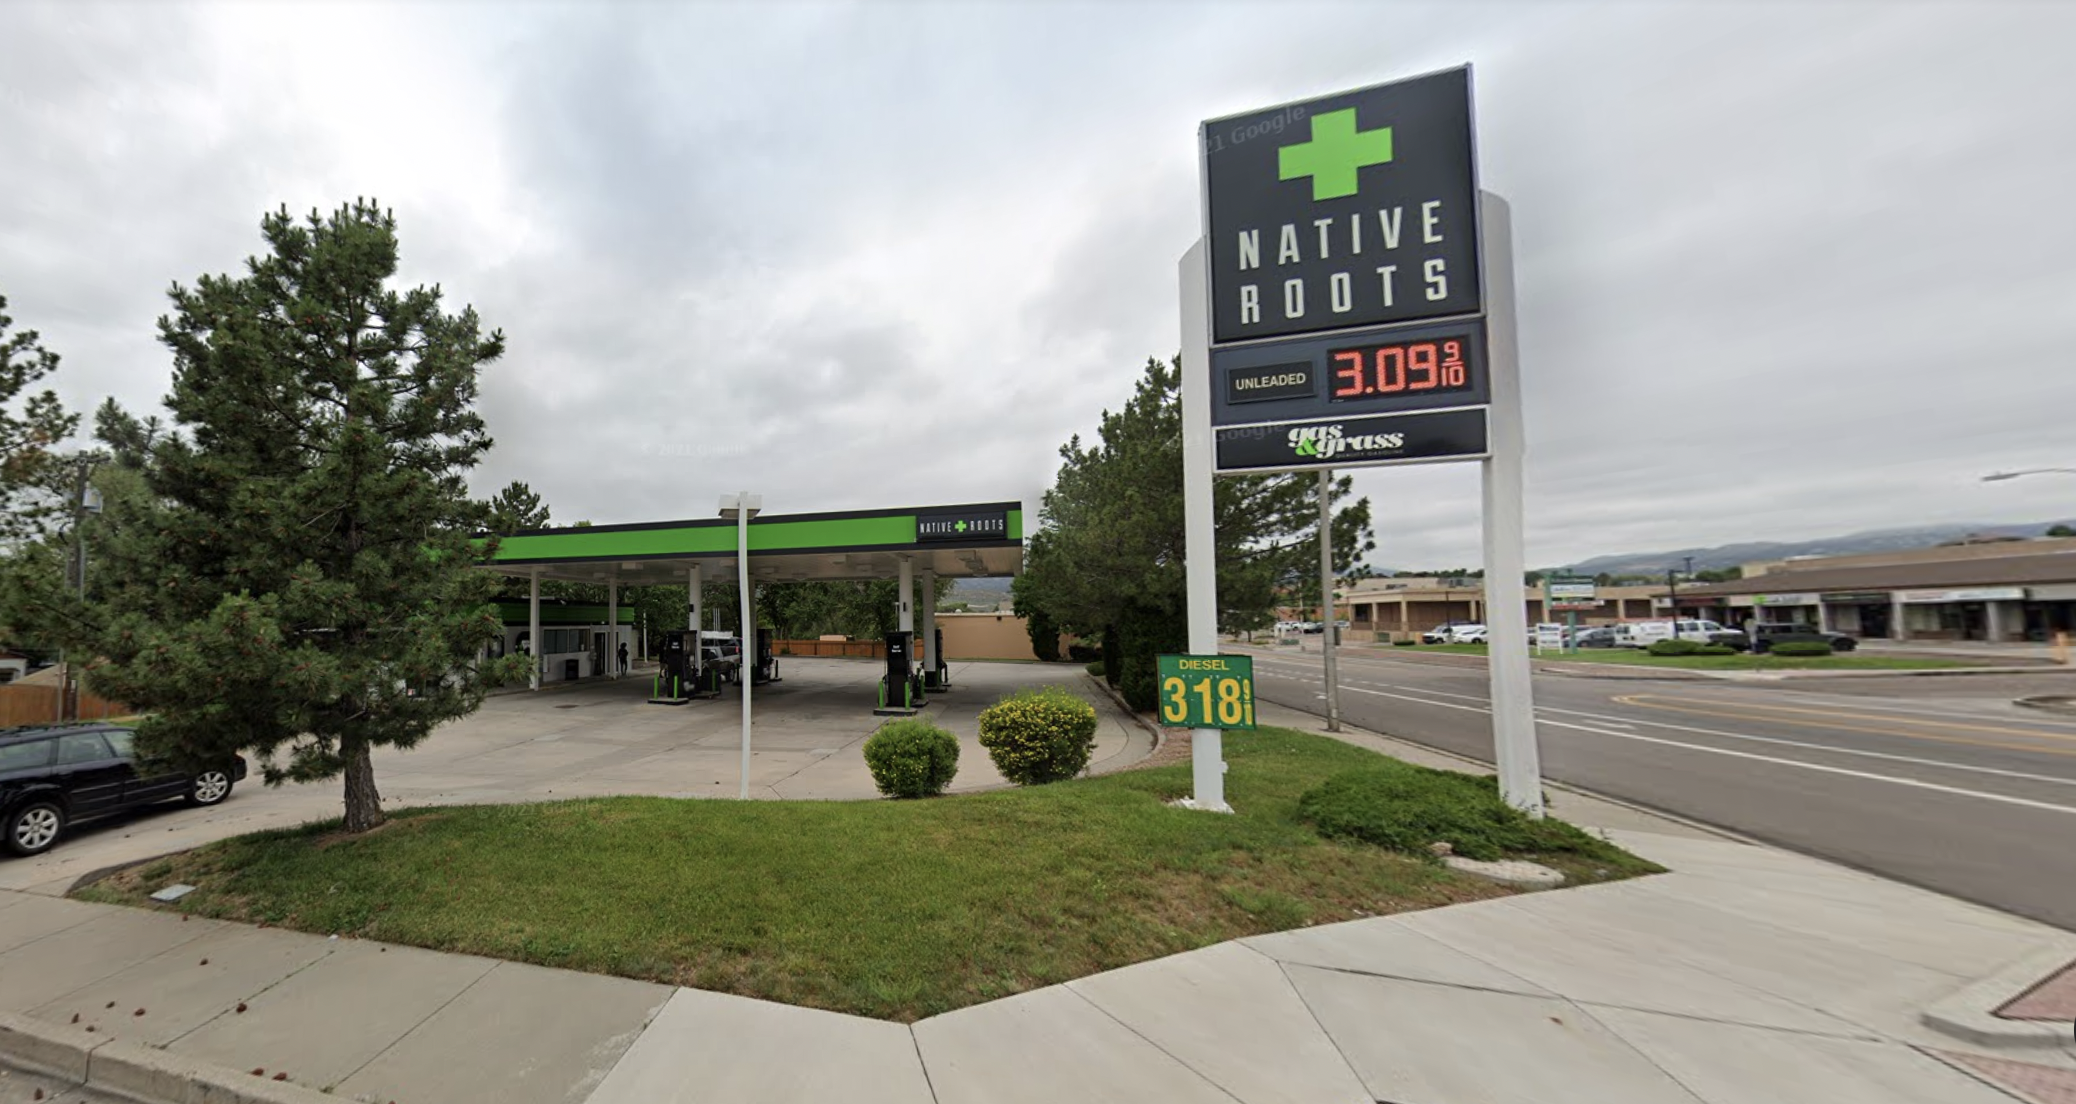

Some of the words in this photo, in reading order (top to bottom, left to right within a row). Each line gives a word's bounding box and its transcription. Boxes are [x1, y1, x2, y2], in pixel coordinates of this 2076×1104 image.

[1239, 200, 1443, 270] NATIVE
[1240, 258, 1448, 325] ROOTS
[1235, 372, 1307, 391] UNLEADED
[1288, 424, 1344, 448] gas
[920, 521, 952, 534] NATIVE
[970, 519, 1004, 532] ROOTS
[1178, 659, 1230, 671] DIESEL
